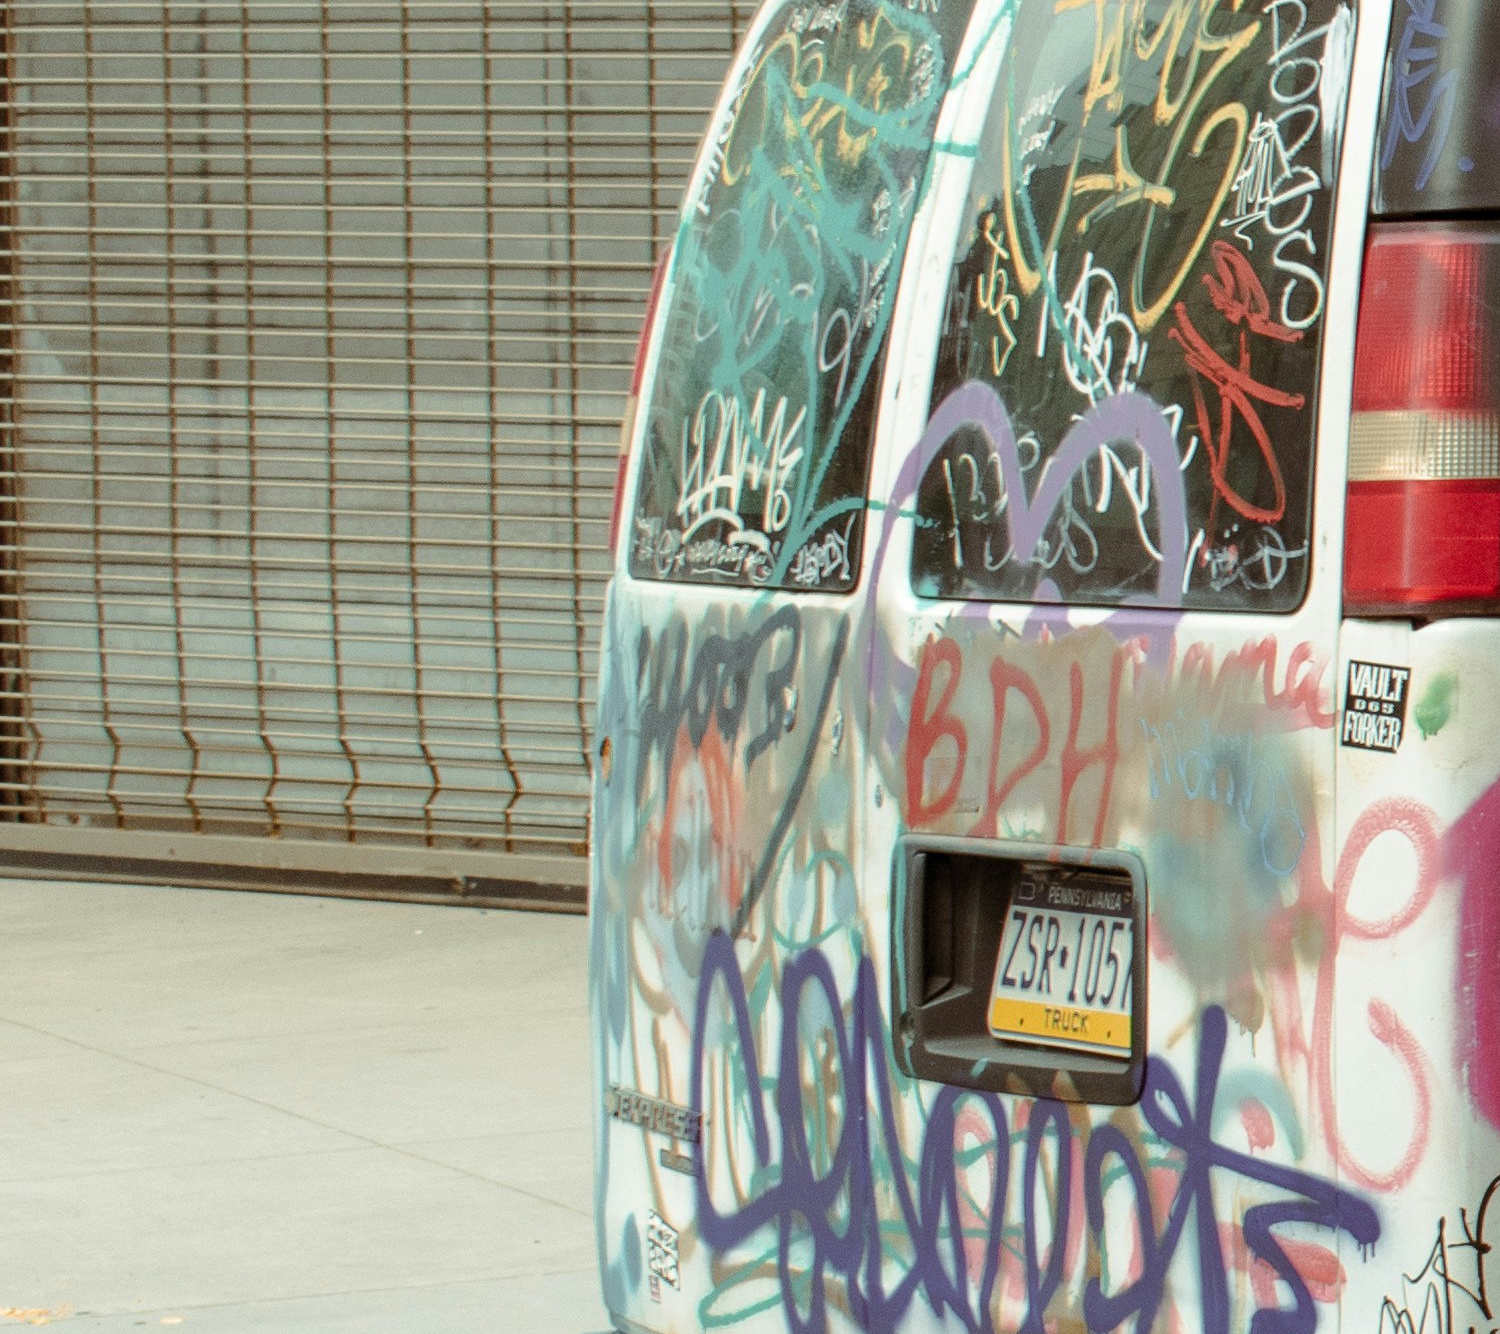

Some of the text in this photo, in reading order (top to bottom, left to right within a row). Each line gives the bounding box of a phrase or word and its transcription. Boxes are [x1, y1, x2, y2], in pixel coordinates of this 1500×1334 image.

[1349, 662, 1410, 702] VAULT
[1342, 709, 1402, 750] FORKER
[1048, 885, 1123, 912] PENNSYLVANIA
[1043, 1007, 1090, 1035] TRUCK
